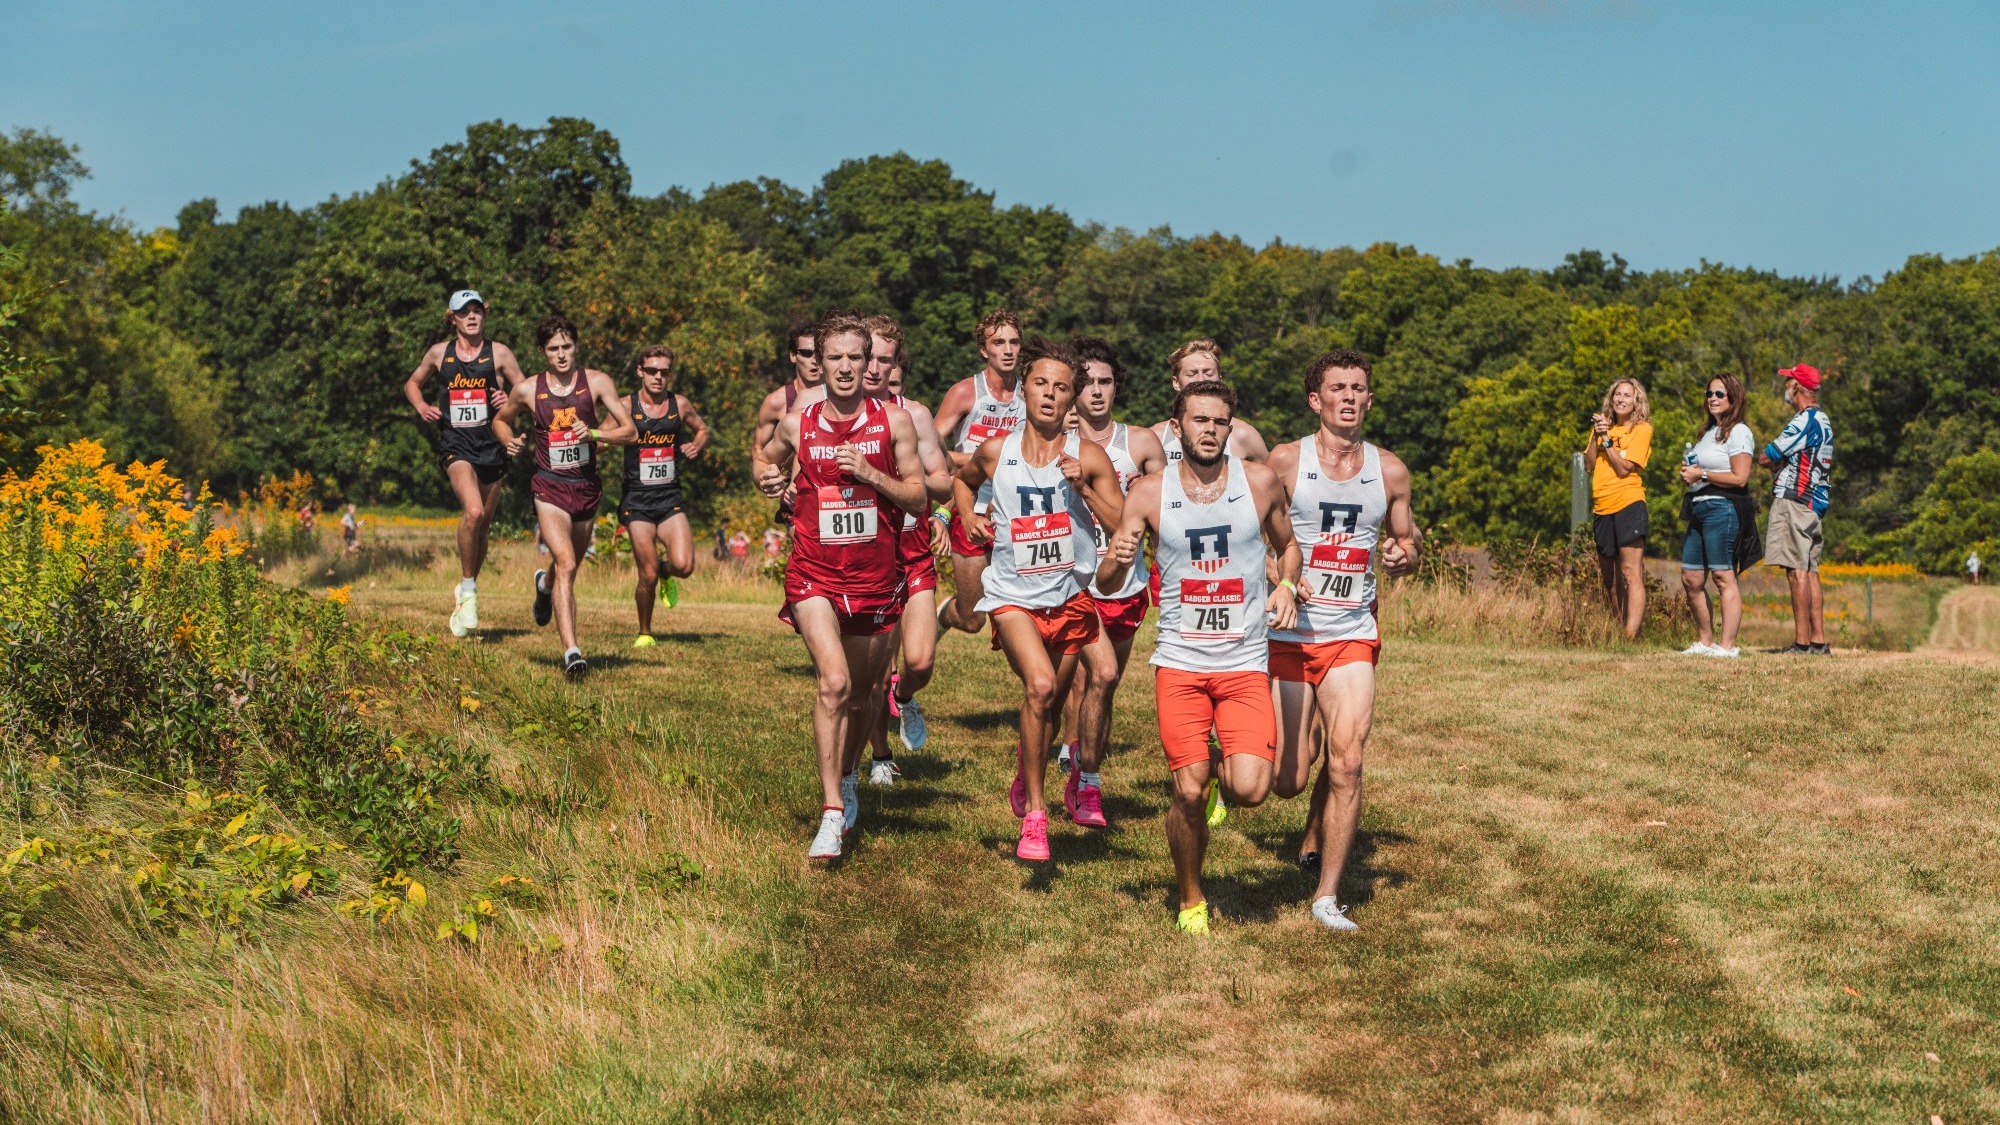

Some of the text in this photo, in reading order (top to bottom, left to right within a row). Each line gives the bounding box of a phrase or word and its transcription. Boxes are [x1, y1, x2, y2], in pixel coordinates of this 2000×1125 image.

[449, 373, 486, 388] Iowa
[458, 407, 477, 421] 751
[981, 415, 1000, 427] OHIO
[558, 447, 580, 463] 769
[808, 440, 881, 460] WISSIN
[648, 464, 668, 478] 756
[821, 499, 874, 509] BADGER CLASSIC
[832, 512, 865, 535] 810
[1015, 527, 1070, 541] BADGER CLASSIC
[1027, 541, 1062, 566] 744
[1313, 559, 1365, 571] BADGER CLASSIC
[1319, 573, 1353, 598] 740
[1212, 594, 1241, 602] CLASSIC
[1194, 607, 1230, 631] 745
